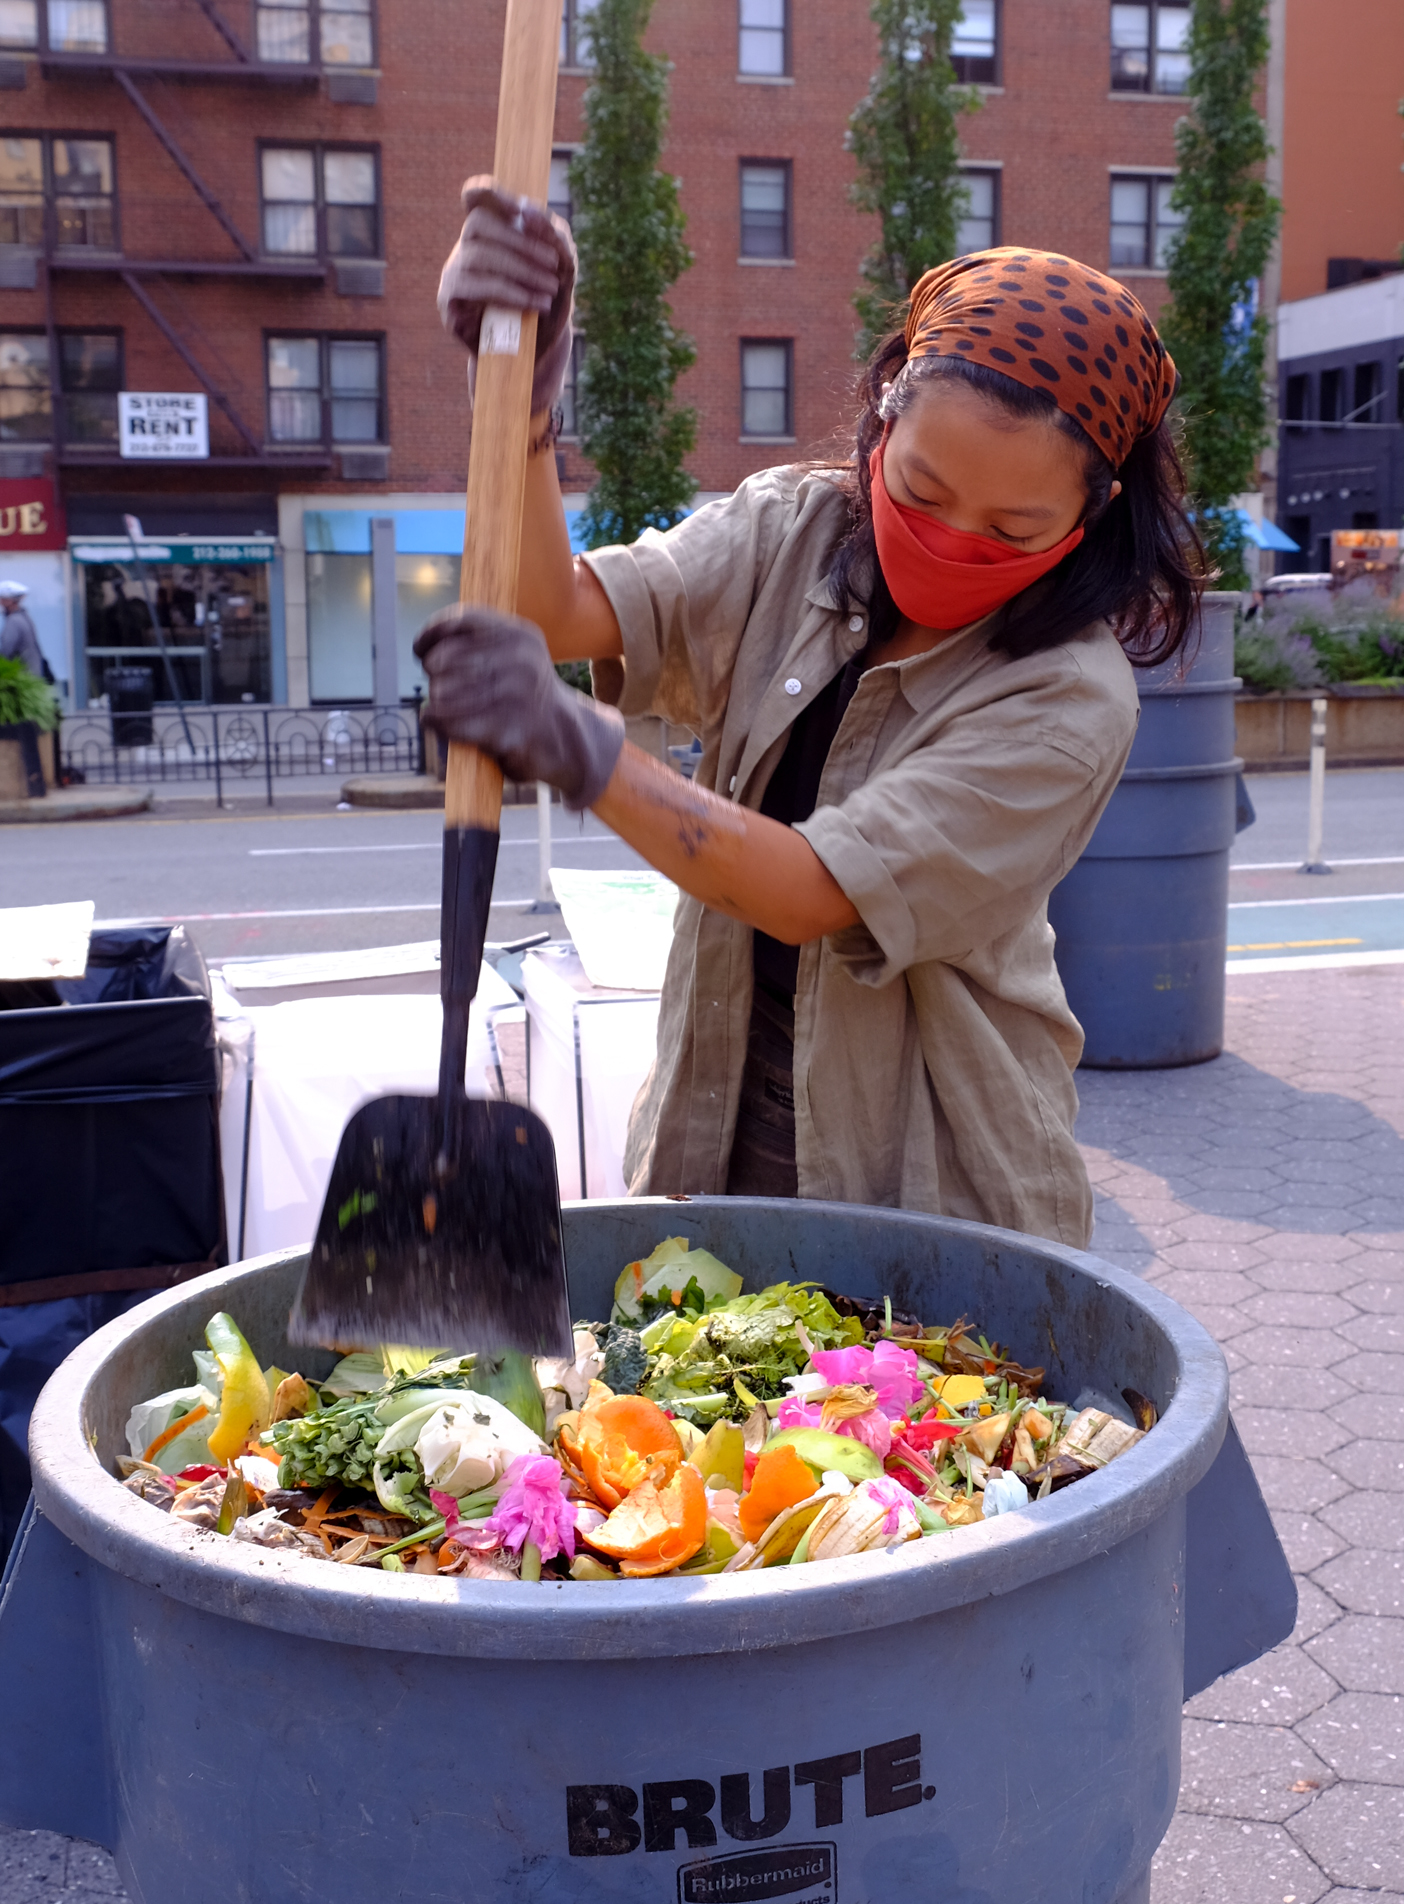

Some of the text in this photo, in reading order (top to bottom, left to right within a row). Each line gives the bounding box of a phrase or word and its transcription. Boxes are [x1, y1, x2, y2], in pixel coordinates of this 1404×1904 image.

[129, 396, 196, 410] STORE
[129, 416, 197, 436] RENT
[691, 1858, 825, 1893] Rubbermaid
